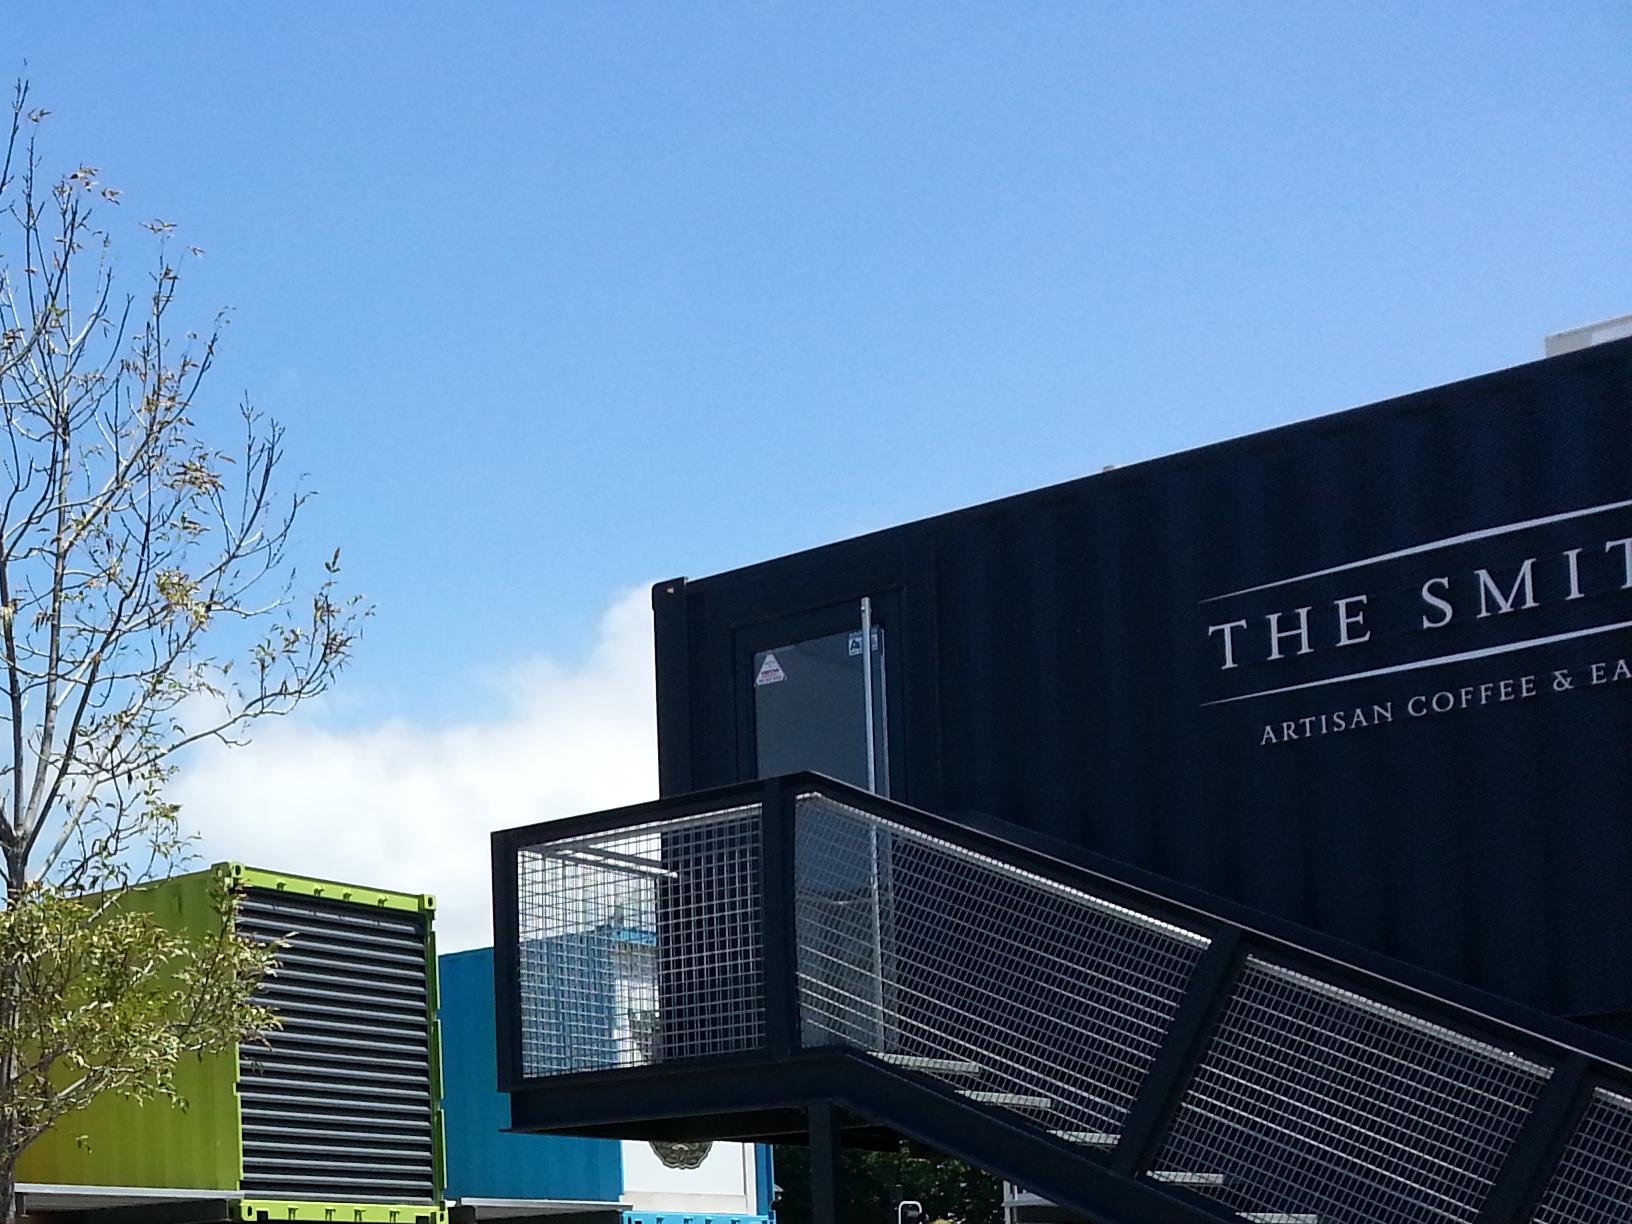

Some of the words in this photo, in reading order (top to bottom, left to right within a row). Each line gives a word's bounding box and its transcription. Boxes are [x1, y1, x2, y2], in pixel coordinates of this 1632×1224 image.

[1207, 594, 1371, 671] THE
[1259, 702, 1395, 746] ARTISAN
[1407, 675, 1537, 718] COFFEE
[1553, 668, 1574, 693] &
